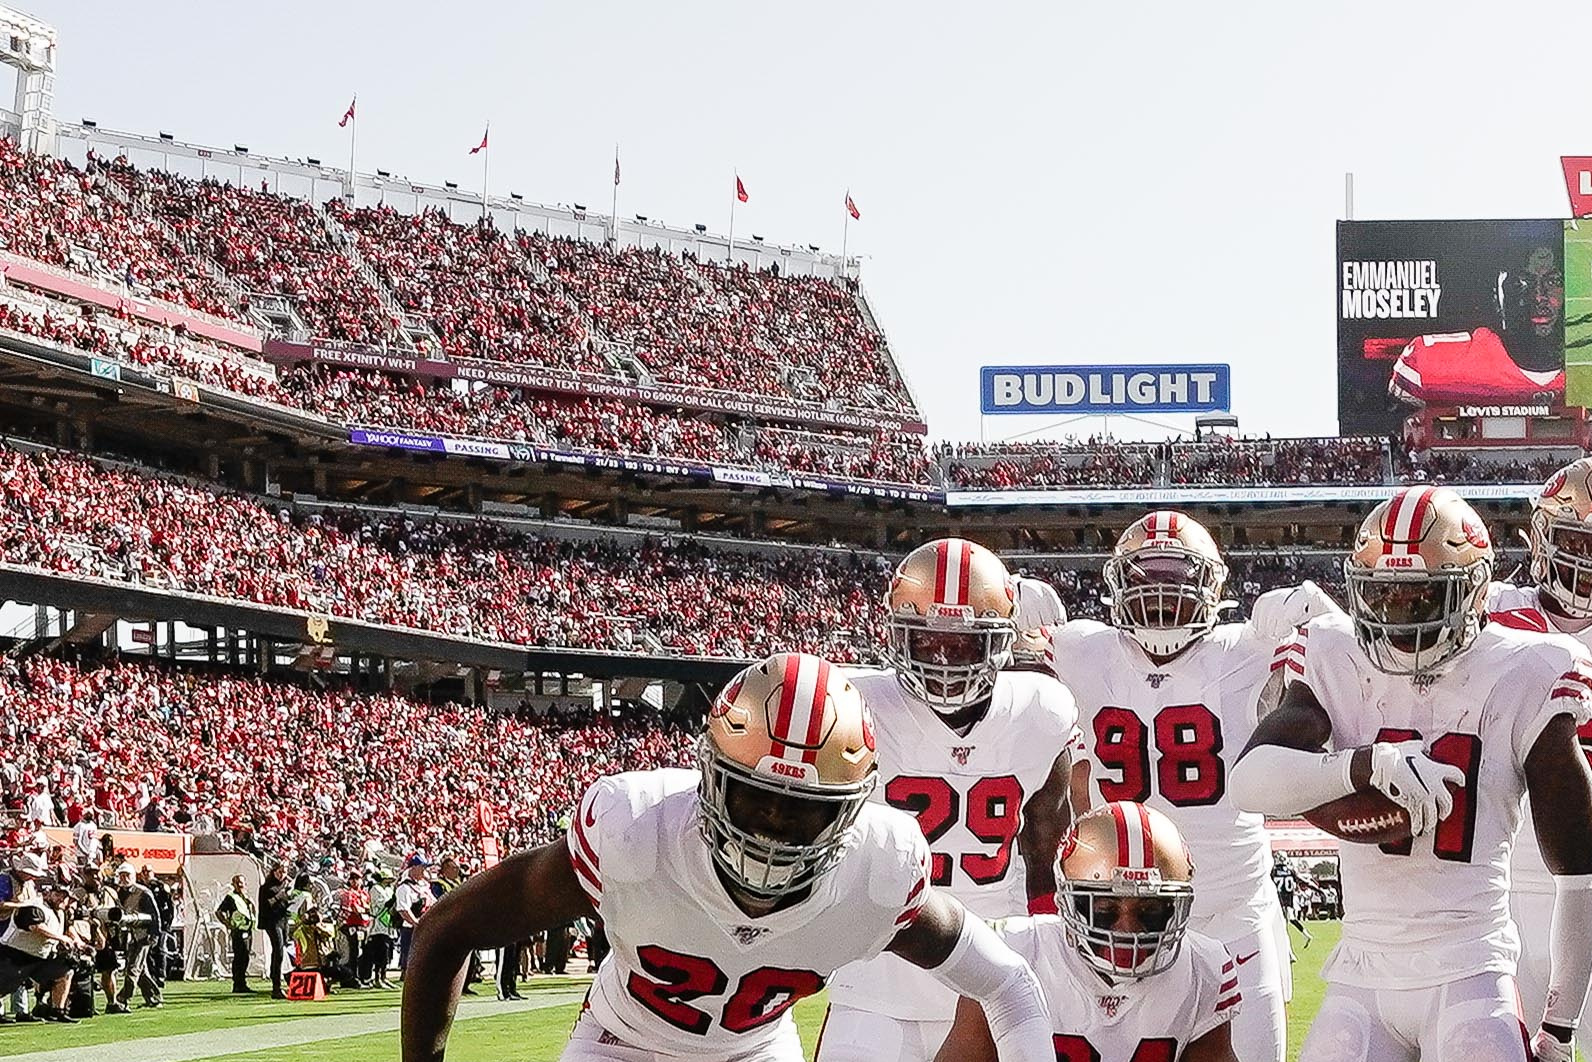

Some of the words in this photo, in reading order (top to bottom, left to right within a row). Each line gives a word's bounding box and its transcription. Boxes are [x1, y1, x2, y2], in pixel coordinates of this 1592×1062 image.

[1342, 260, 1441, 290] EMMANUEL
[1342, 288, 1442, 319] MOSELEY
[313, 348, 341, 361] FREE
[342, 351, 386, 368] XFINITY
[387, 358, 416, 370] WI-FI
[458, 367, 485, 379] NEED
[487, 370, 553, 388] ASSISTANCE?
[555, 379, 580, 391] TEXT
[638, 389, 651, 399] TO
[685, 394, 699, 405] OR
[700, 396, 723, 407] CALL
[724, 399, 752, 413] GUEST
[754, 403, 796, 418] SERVICES
[797, 408, 835, 423] HOTLINE
[993, 373, 1086, 406] BUD
[1089, 372, 1217, 405] LIGHT
[1501, 406, 1549, 416] STADIUM
[454, 444, 499, 455] PASSING
[722, 472, 761, 483] PASSING
[1385, 557, 1413, 568] 49ERS
[1093, 703, 1225, 807] 98
[771, 762, 806, 780] 49ERS
[1374, 727, 1482, 863] 1
[885, 774, 1024, 886] 29
[1123, 870, 1149, 881] 49ERS
[1273, 876, 1294, 892] 70
[290, 975, 315, 997] 20
[627, 944, 827, 1036] 20
